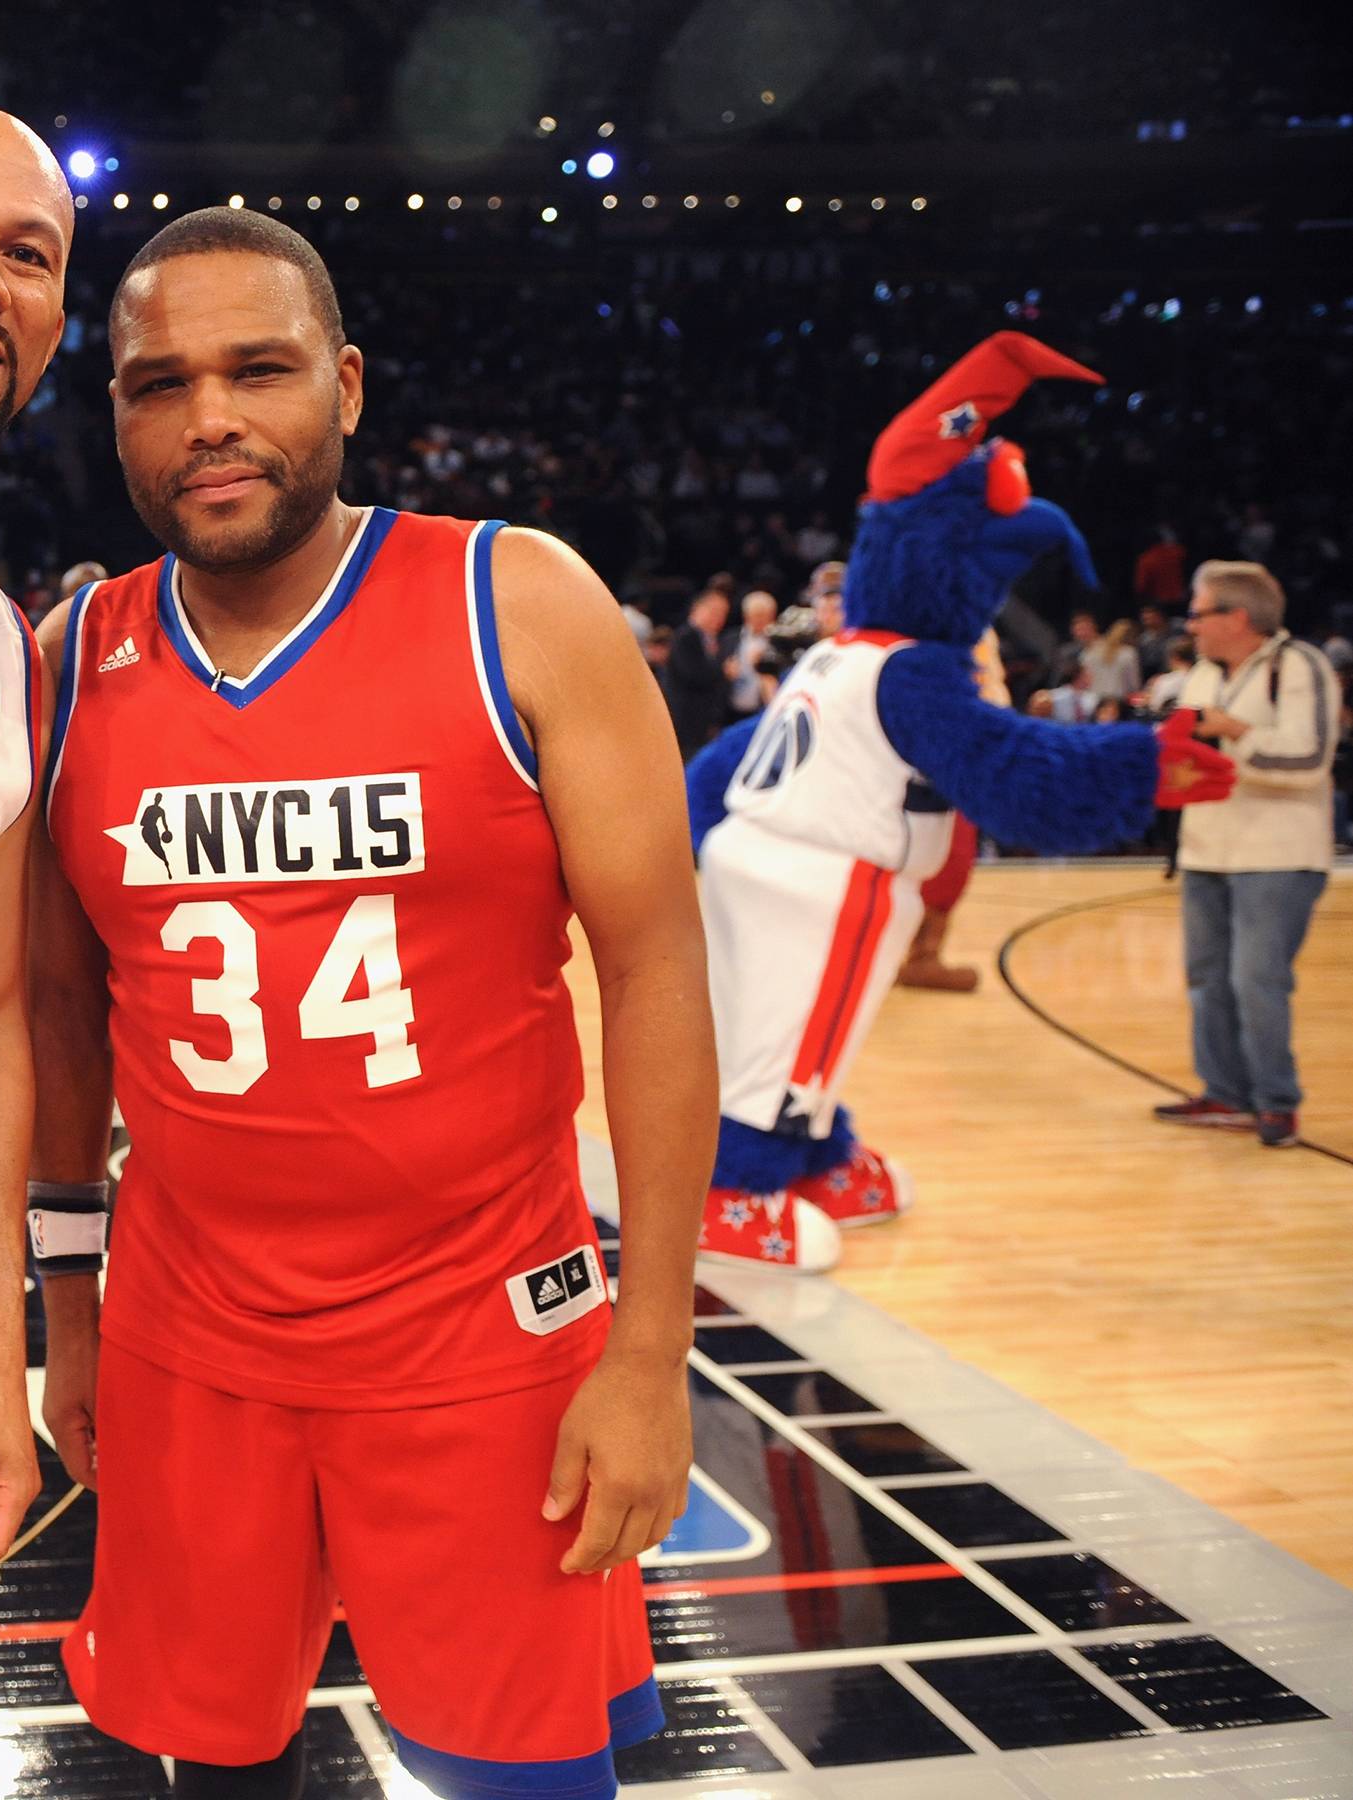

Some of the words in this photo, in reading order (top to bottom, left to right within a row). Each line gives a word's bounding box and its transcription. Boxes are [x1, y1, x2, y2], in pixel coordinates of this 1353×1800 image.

[98, 652, 141, 673] adidas
[185, 789, 314, 876] NYC
[329, 782, 412, 872] 15
[159, 893, 423, 1096] 34
[537, 1288, 564, 1305] adidas
